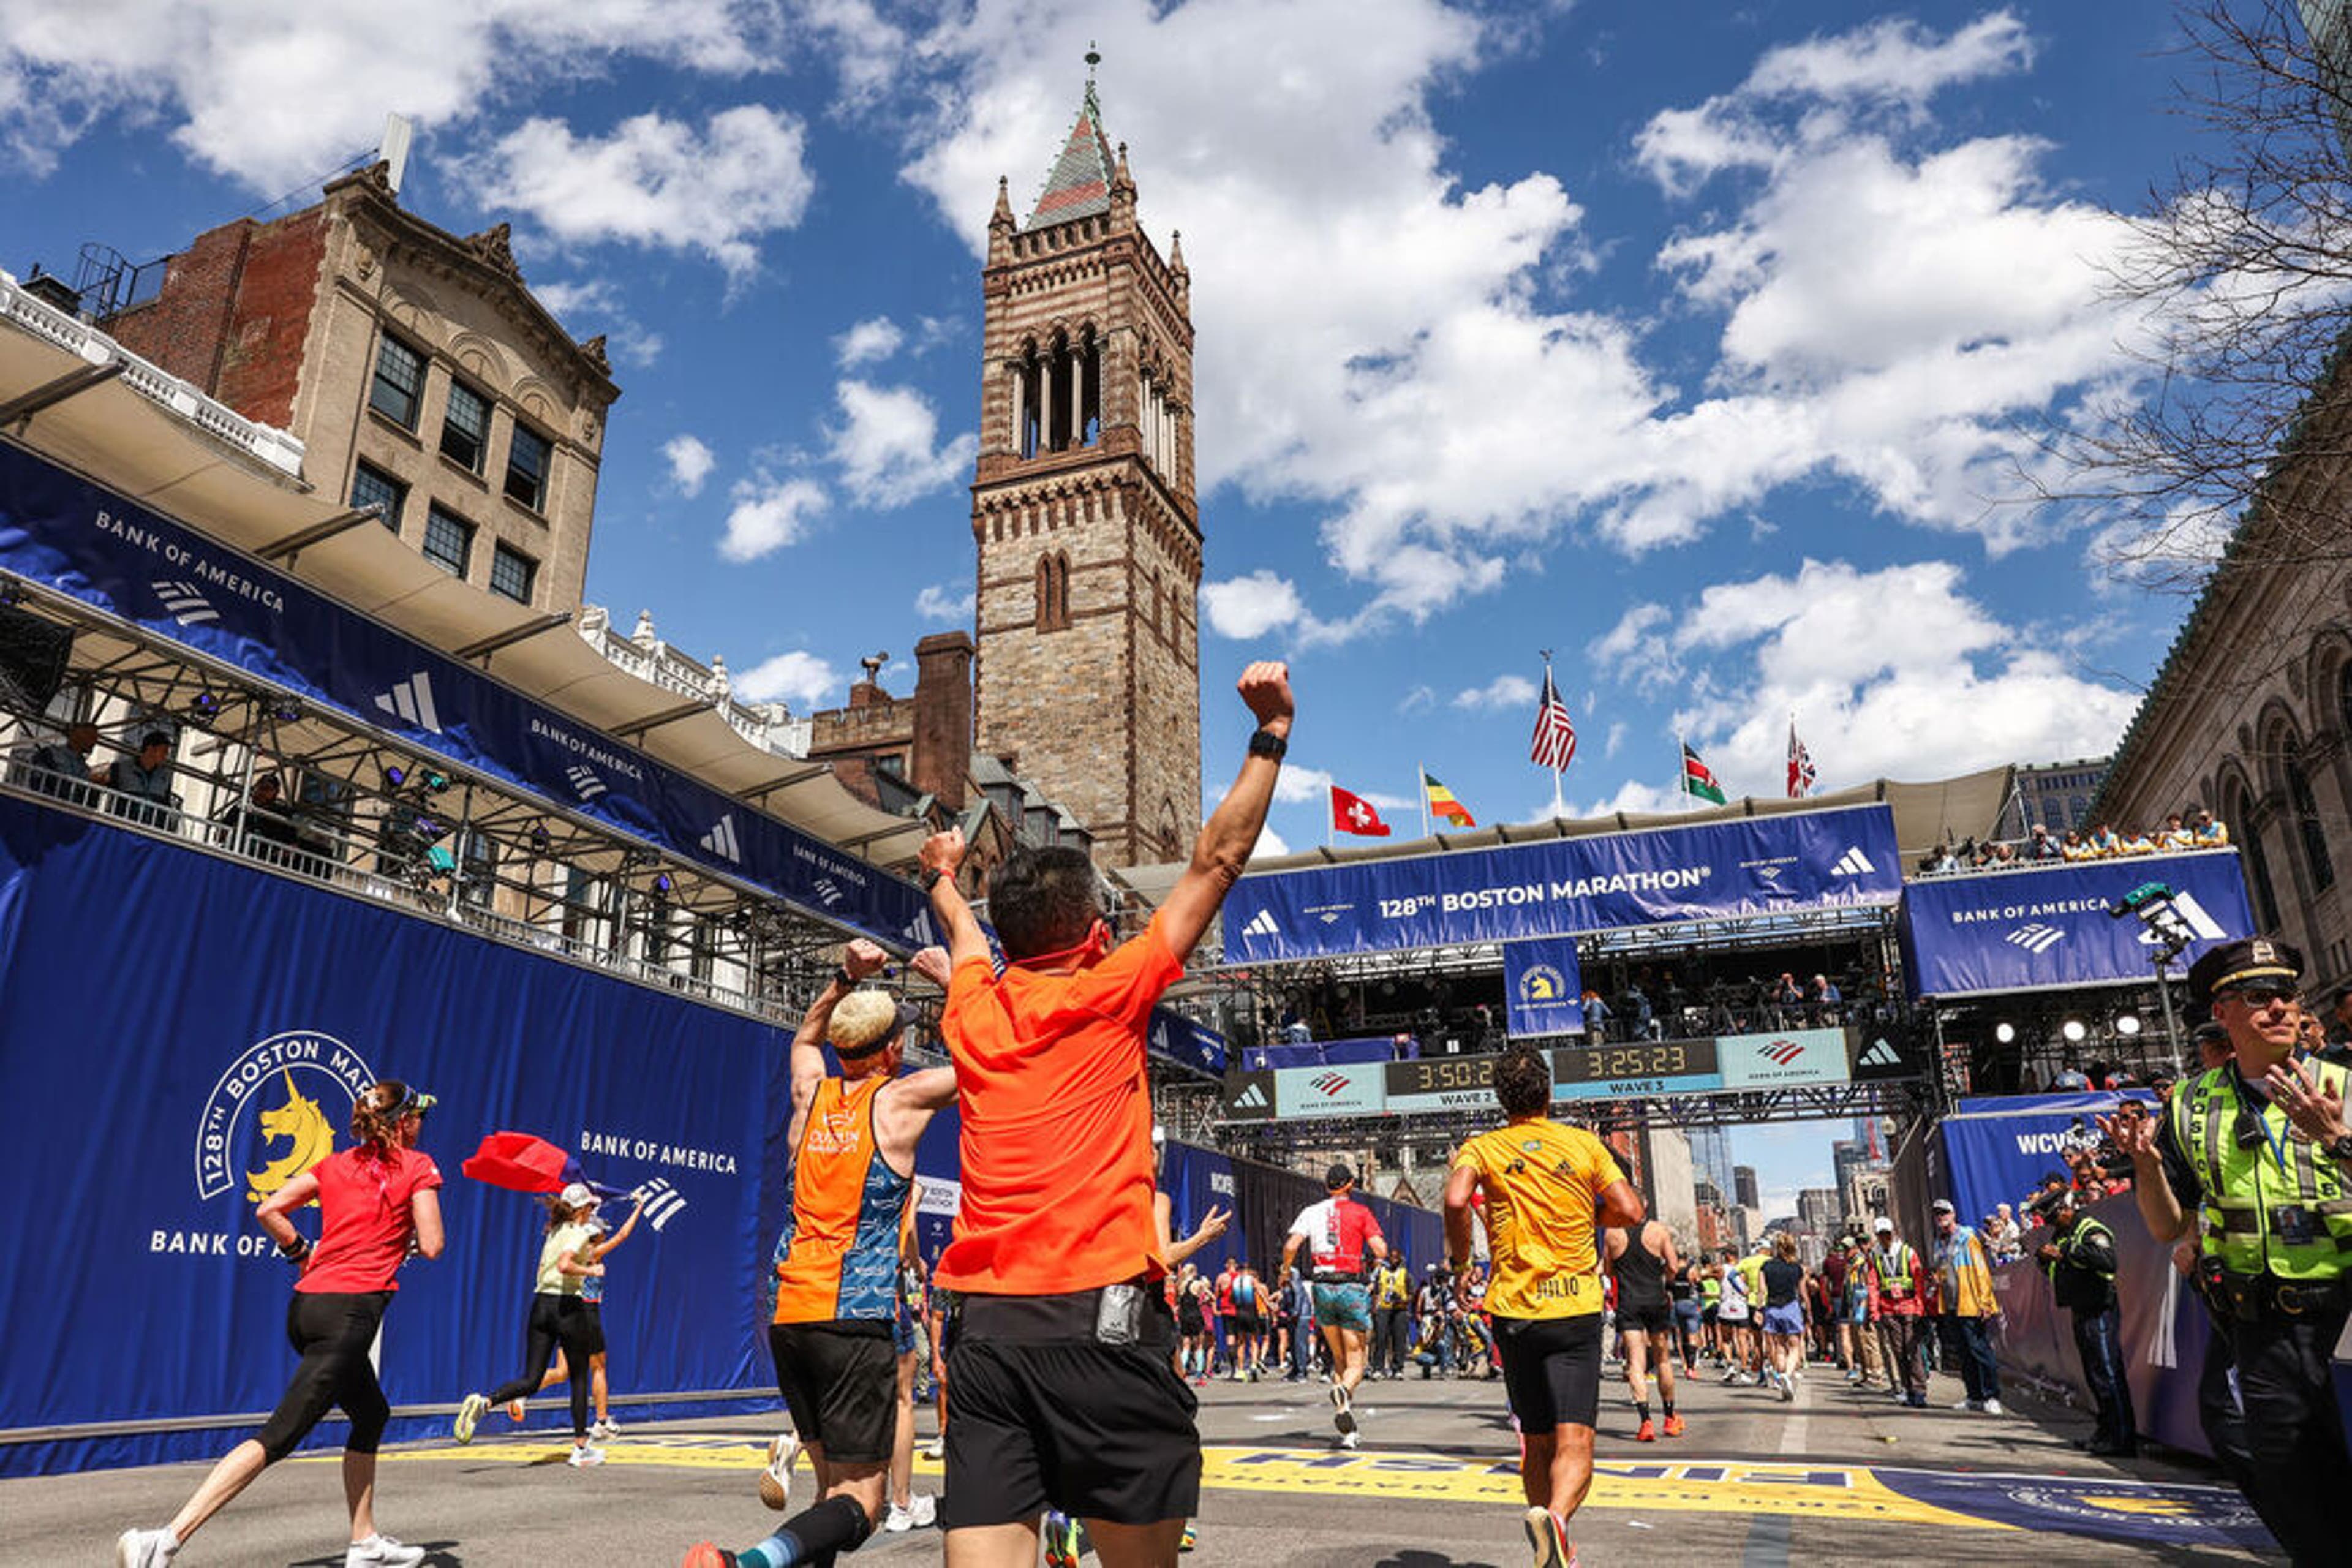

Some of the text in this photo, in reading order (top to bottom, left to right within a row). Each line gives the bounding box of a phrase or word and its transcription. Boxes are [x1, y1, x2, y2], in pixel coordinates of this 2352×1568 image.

[96, 511, 284, 612] BANK OF AMERICA
[532, 718, 643, 780] BANK OF AMERICA
[1379, 895, 1435, 918] 128TH
[1442, 883, 1544, 911] BOSTON
[1952, 897, 2110, 923] BANK OF AMERICA
[1419, 1061, 1493, 1089] 3:50:2
[1588, 1047, 1685, 1077] 3:25:23
[1440, 1092, 1480, 1106] WAVE
[1609, 1081, 1664, 1094] WAVE 3
[205, 1040, 319, 1184] 128TH BOSTON
[581, 1131, 736, 1174] BANK OF AMERICA
[151, 1230, 228, 1254] BANK
[237, 1235, 266, 1256] OF
